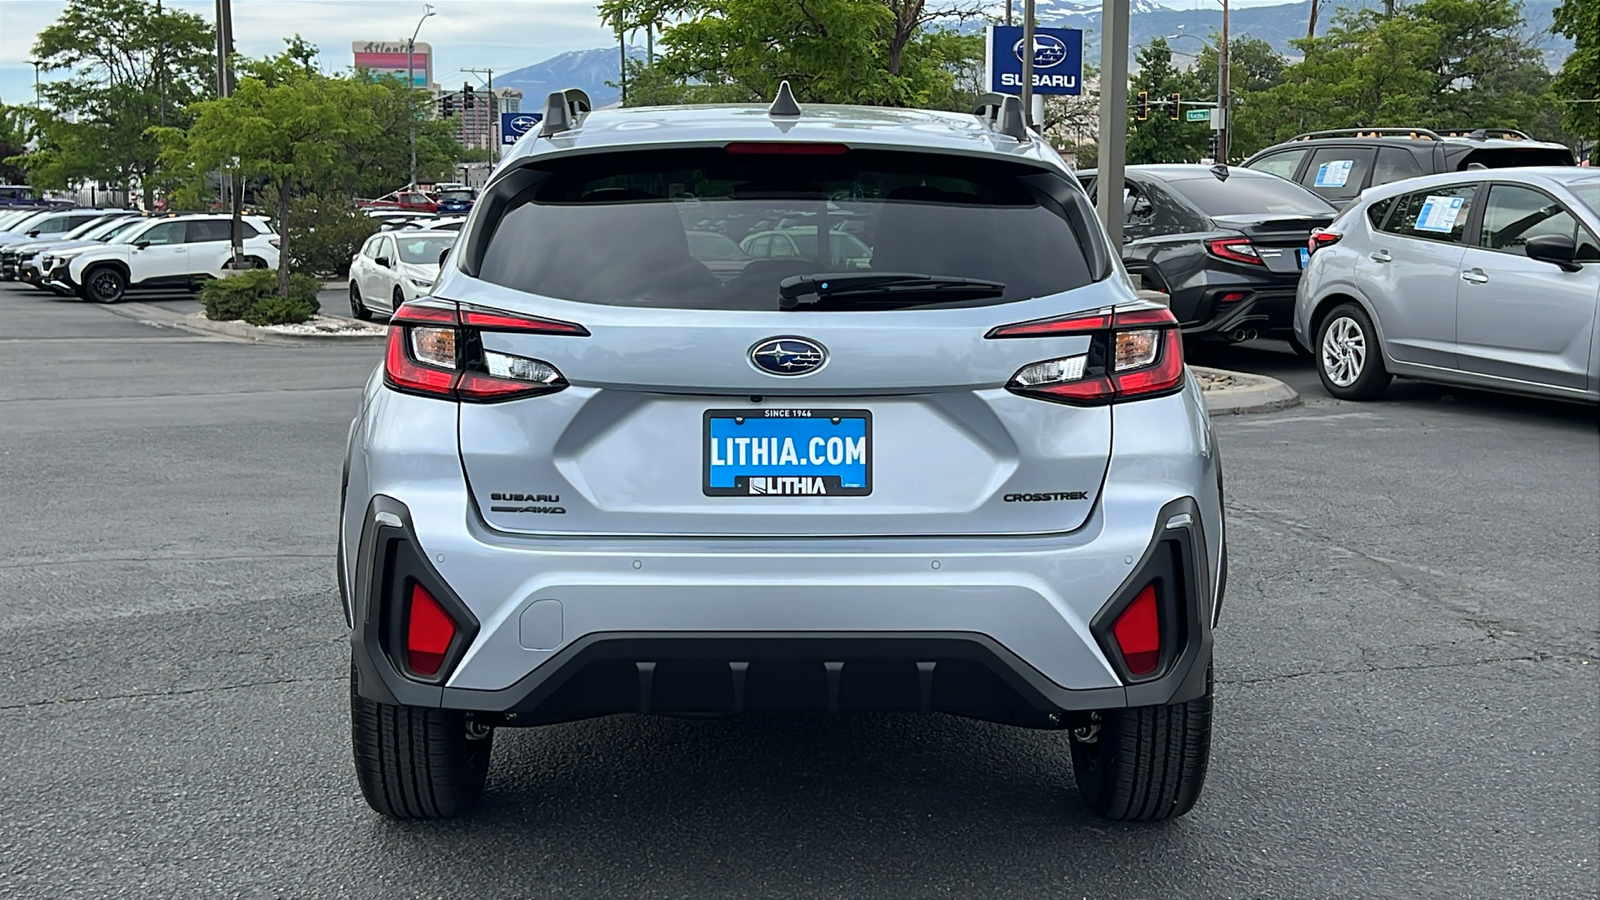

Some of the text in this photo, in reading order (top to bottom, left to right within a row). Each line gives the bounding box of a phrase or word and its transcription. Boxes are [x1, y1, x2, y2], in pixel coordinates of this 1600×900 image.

[1001, 73, 1076, 87] SUBARU
[711, 436, 867, 466] LITHIA.COM
[767, 477, 827, 494] LITHIA
[490, 493, 560, 502] SUBARU
[1003, 491, 1087, 502] CROSSTREK
[518, 506, 566, 514] AWD
